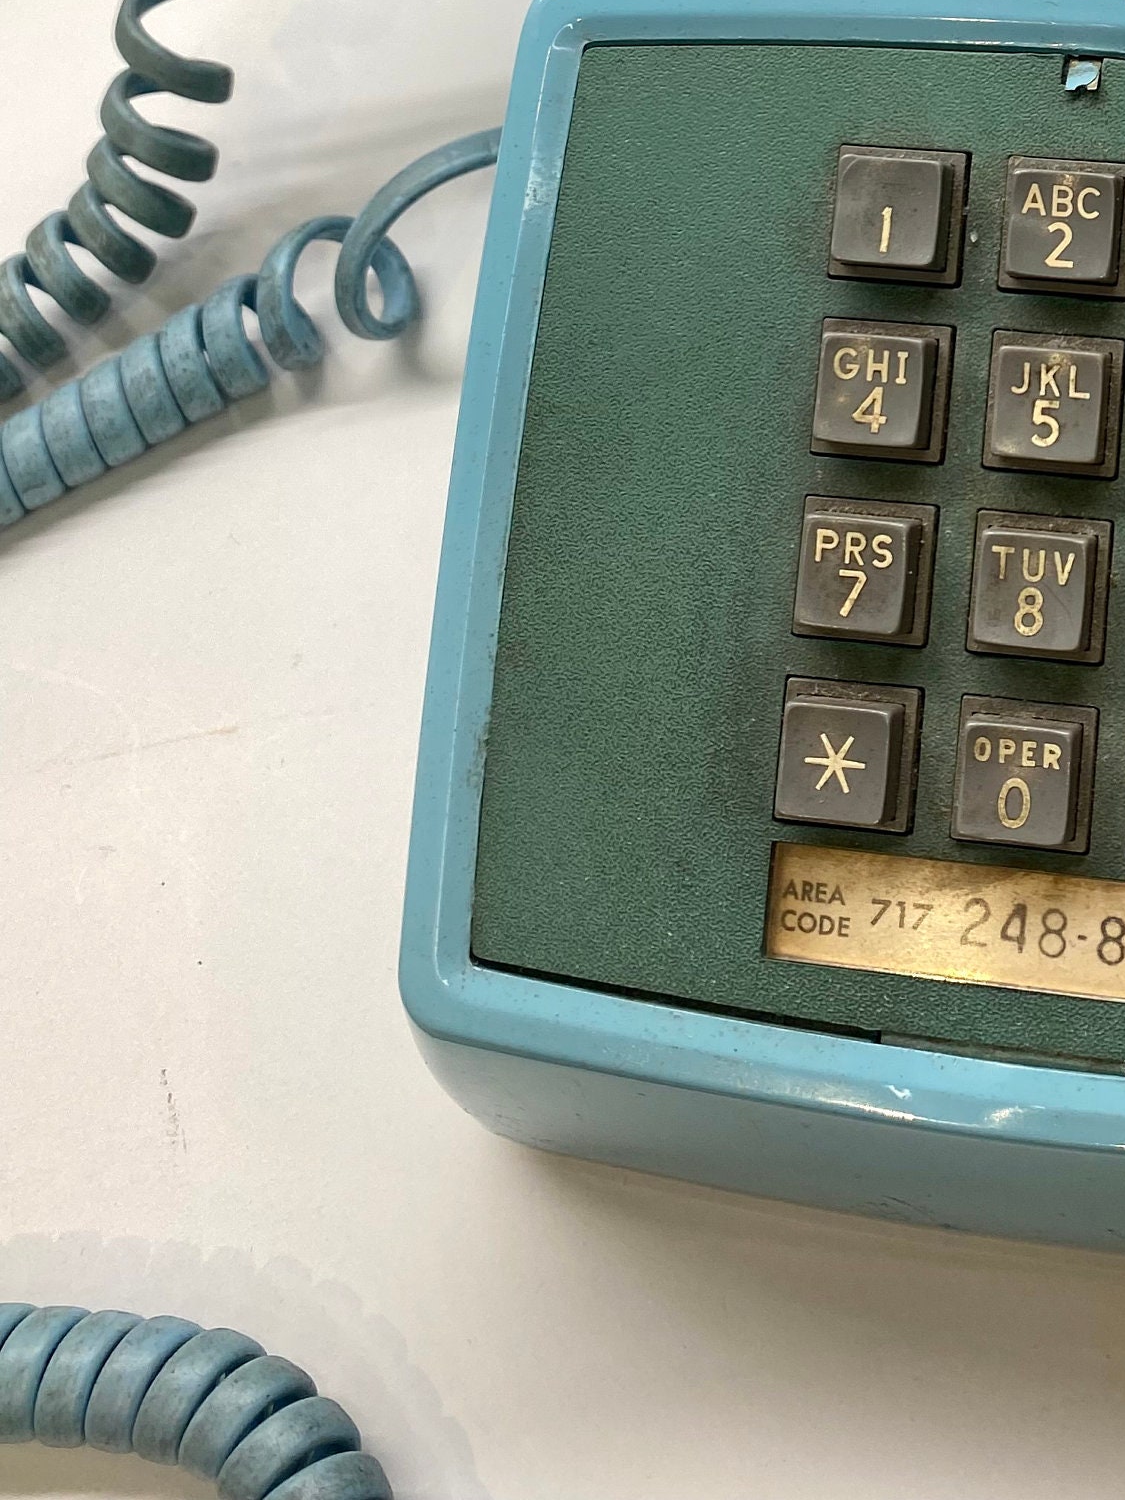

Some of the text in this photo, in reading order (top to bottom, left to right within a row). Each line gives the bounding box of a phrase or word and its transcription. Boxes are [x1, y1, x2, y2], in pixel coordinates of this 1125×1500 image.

[1021, 184, 1101, 220] ABC
[880, 206, 893, 253] 1
[1044, 222, 1074, 269] 2
[833, 347, 909, 385] GHI
[1011, 362, 1091, 400] JKL
[851, 386, 888, 434] 4
[1031, 400, 1061, 448] 5
[814, 529, 894, 569] PRS
[991, 545, 1075, 586] TUV
[838, 569, 868, 617] 7
[1013, 587, 1045, 637] 8
[973, 736, 1061, 771] OPER
[997, 778, 1032, 829] 0
[783, 880, 846, 906] AREA
[780, 910, 851, 938] CODE
[871, 899, 934, 931] 717
